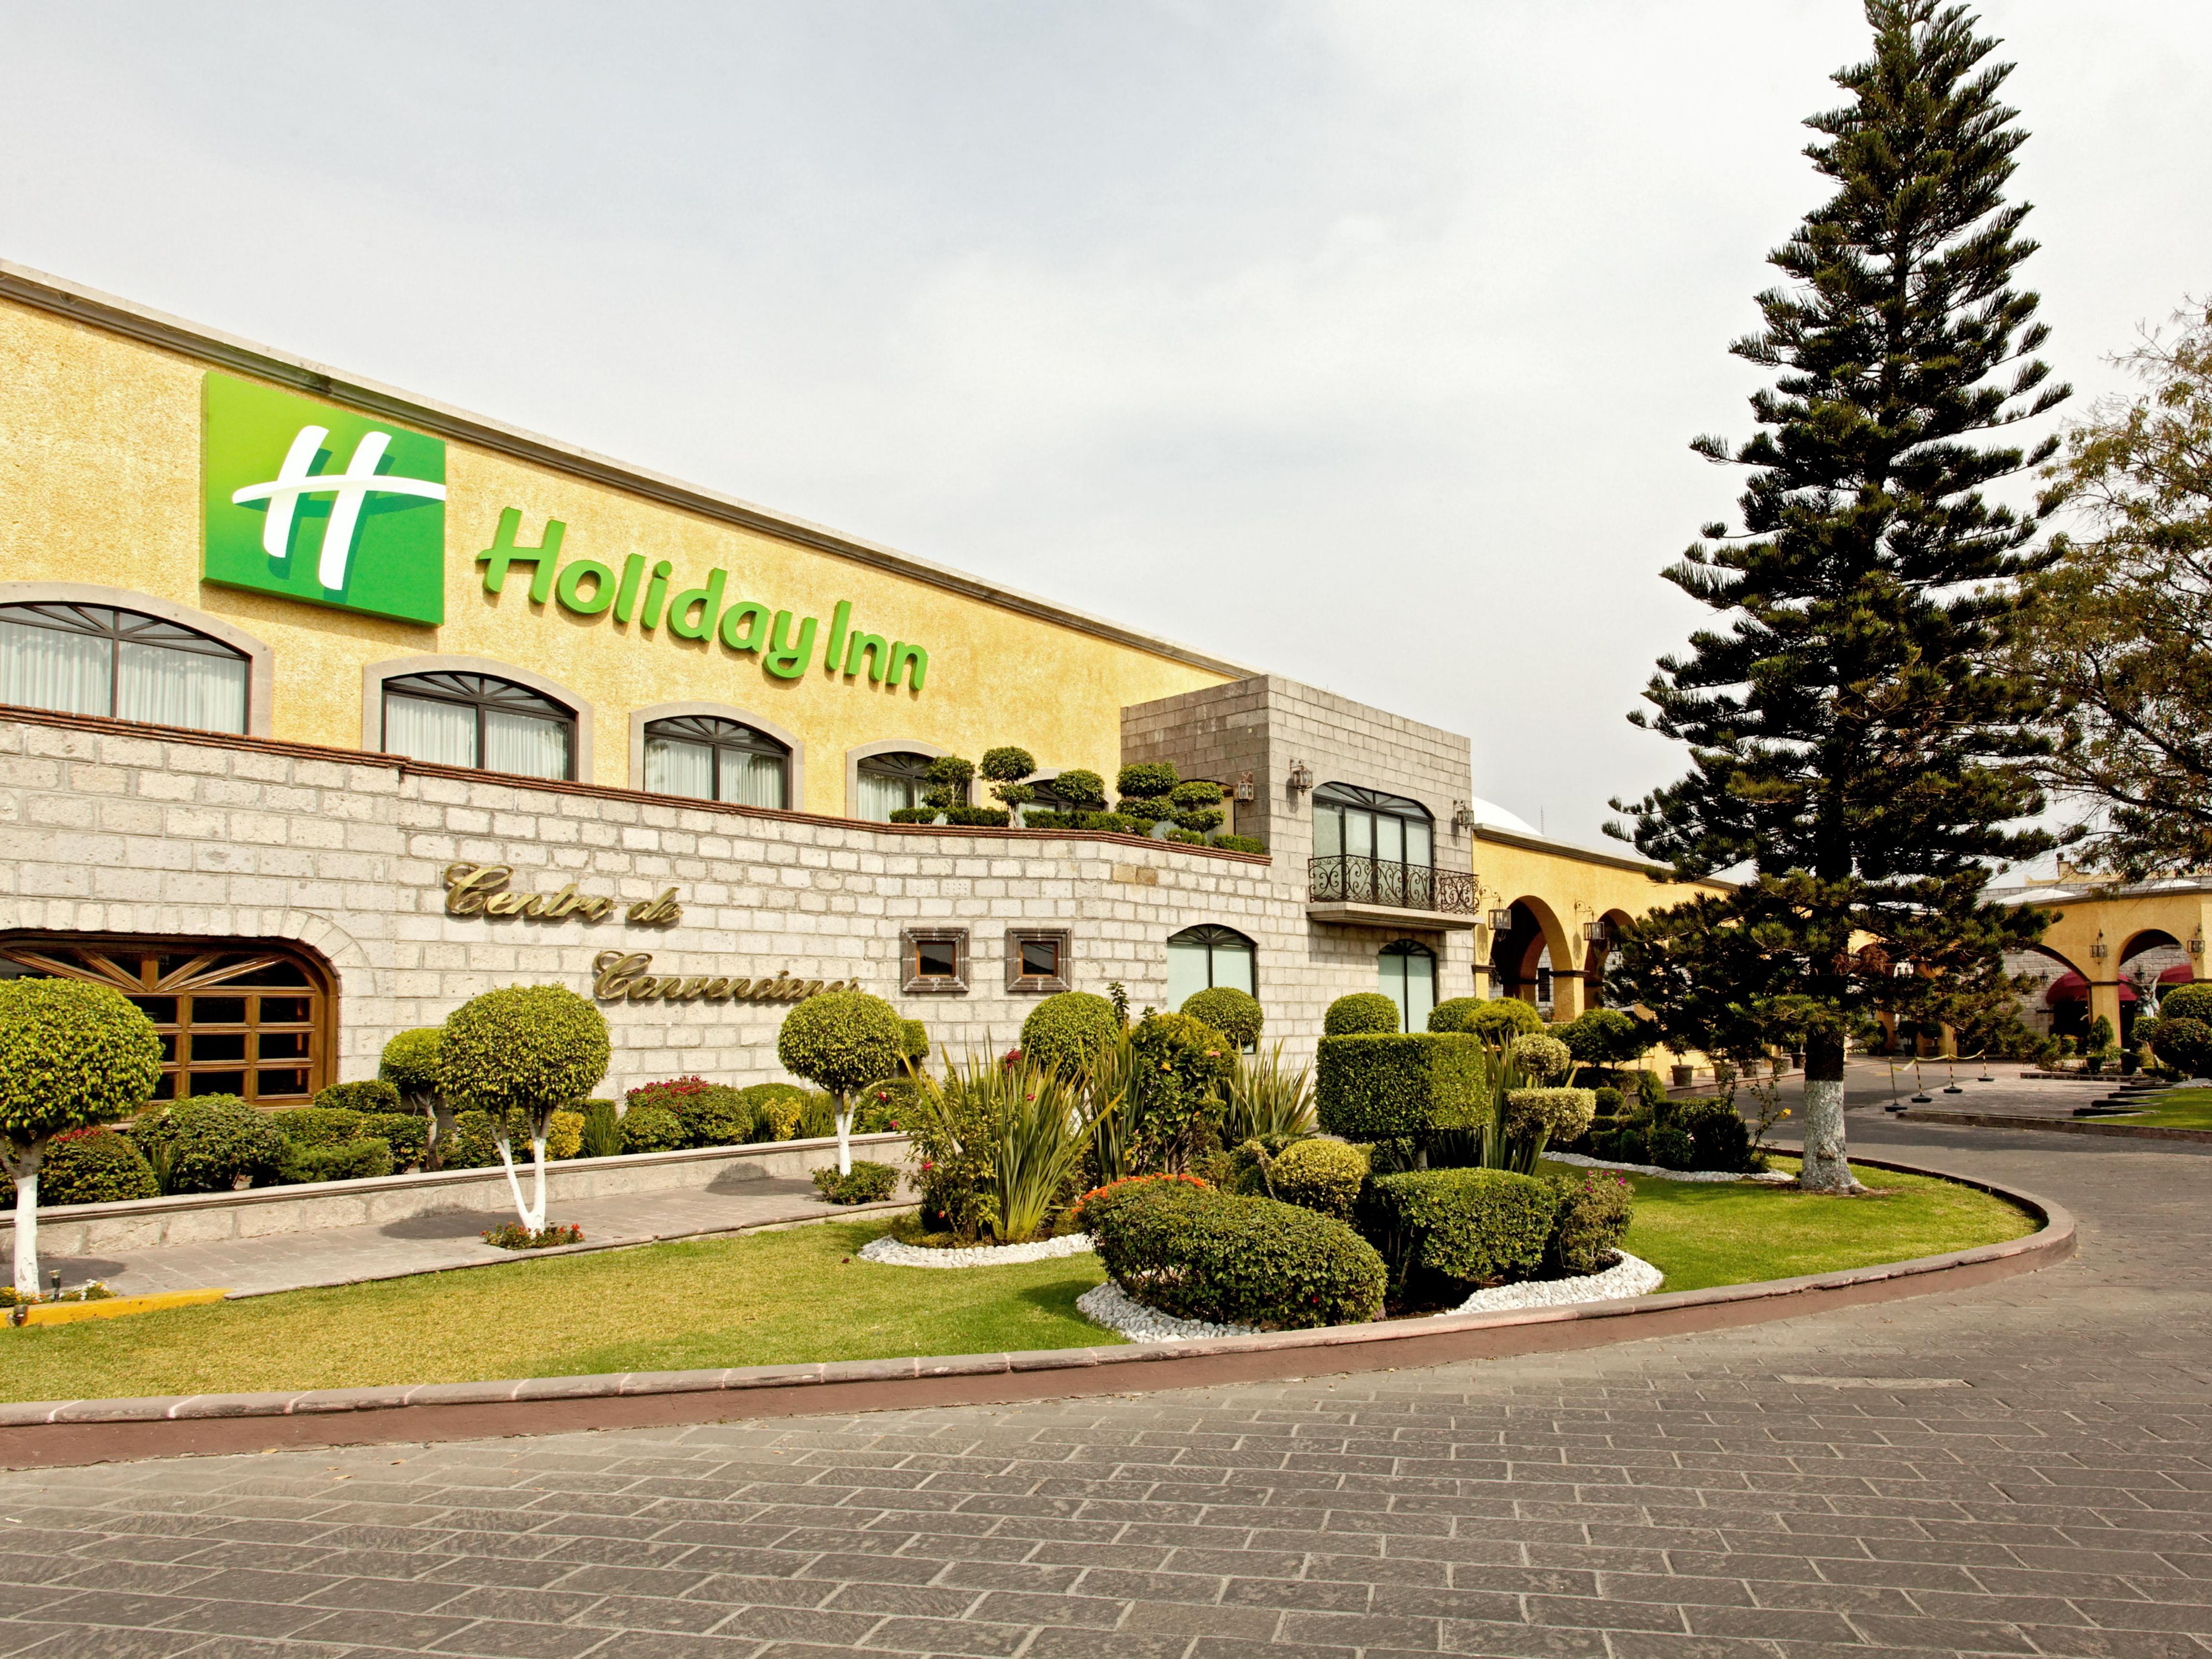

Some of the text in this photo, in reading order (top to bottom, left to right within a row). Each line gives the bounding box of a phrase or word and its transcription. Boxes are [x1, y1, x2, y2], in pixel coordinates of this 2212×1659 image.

[478, 507, 928, 691] Holiday Inn
[444, 862, 684, 923] Centro de
